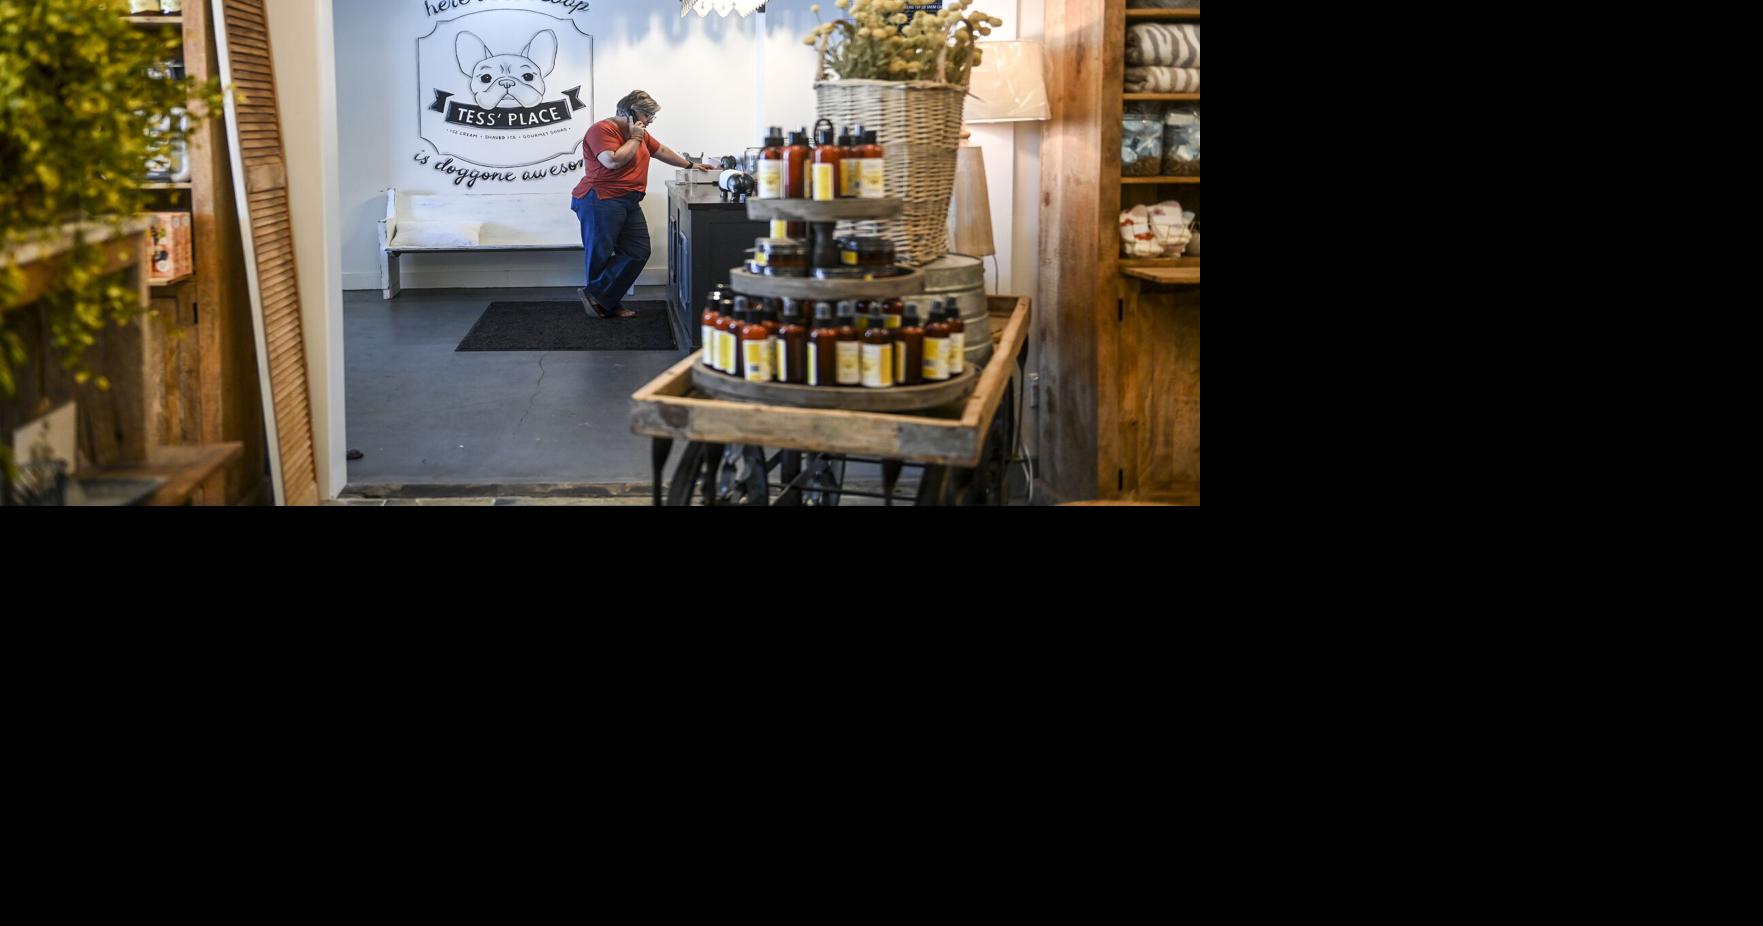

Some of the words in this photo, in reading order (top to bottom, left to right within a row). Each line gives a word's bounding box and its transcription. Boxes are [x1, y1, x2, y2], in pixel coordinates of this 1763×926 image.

[458, 108, 501, 126] TESS'
[508, 107, 561, 126] PLACE
[523, 131, 549, 139] GOURMET
[413, 149, 430, 165] is
[434, 157, 517, 188] doggone
[522, 158, 584, 181] aweso
